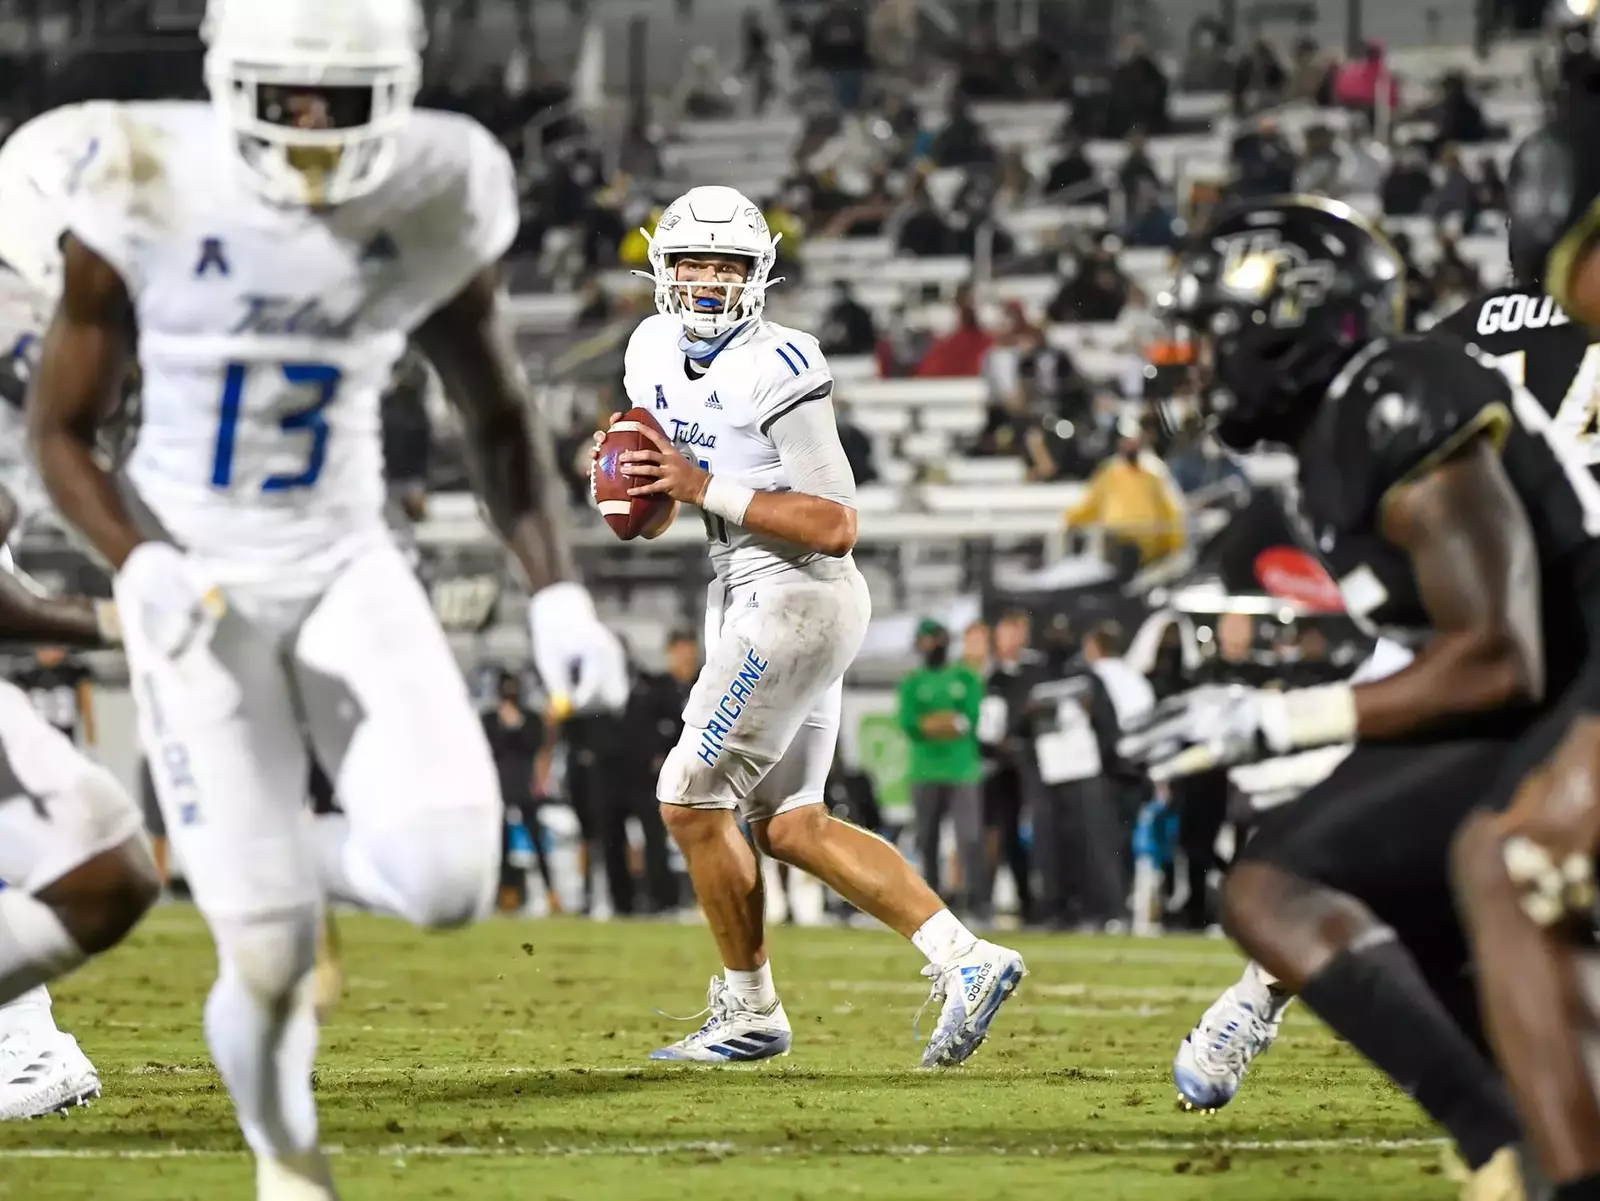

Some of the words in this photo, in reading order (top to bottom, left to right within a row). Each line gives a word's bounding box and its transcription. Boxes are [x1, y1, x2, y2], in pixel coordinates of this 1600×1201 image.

[775, 341, 809, 377] 11
[211, 361, 341, 492] 13
[670, 418, 716, 449] Tulsa
[967, 962, 993, 1002] adidas
